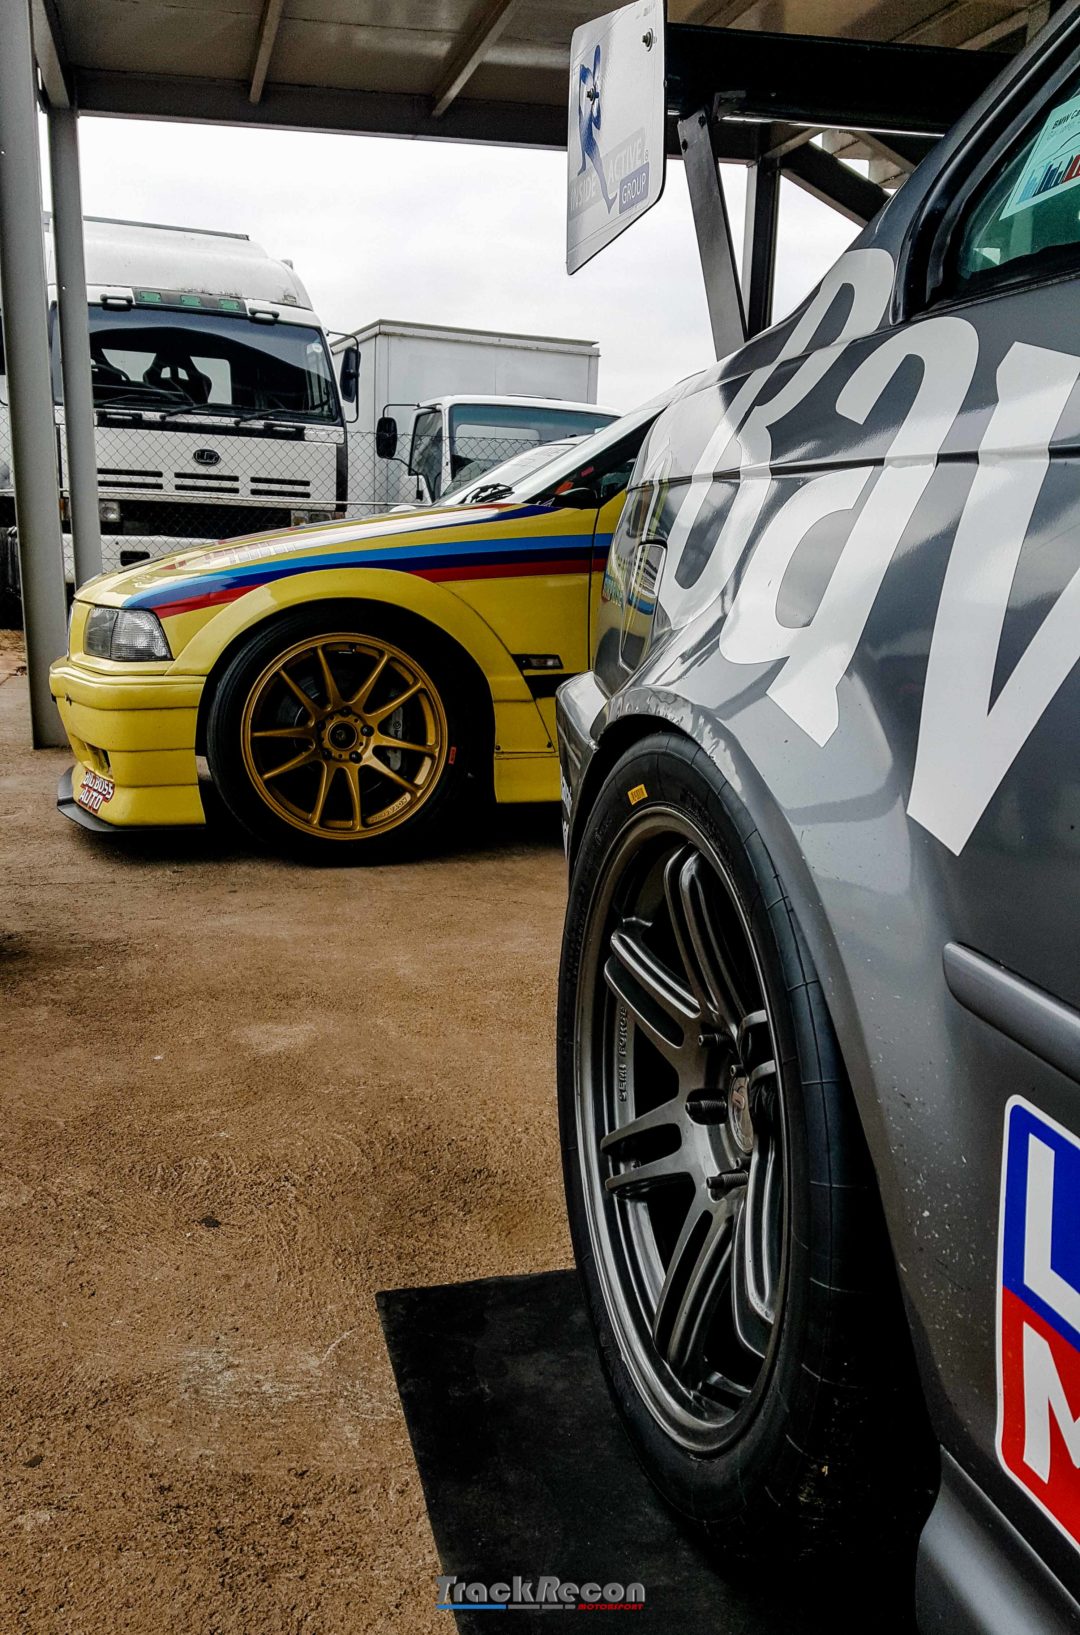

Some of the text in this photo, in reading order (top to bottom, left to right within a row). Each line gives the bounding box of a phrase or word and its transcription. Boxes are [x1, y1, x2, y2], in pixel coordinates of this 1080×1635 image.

[570, 138, 643, 212] INSIDE ACTIVE
[621, 172, 646, 205] GROUP
[79, 787, 103, 810] AUTO
[94, 777, 114, 798] BOSS
